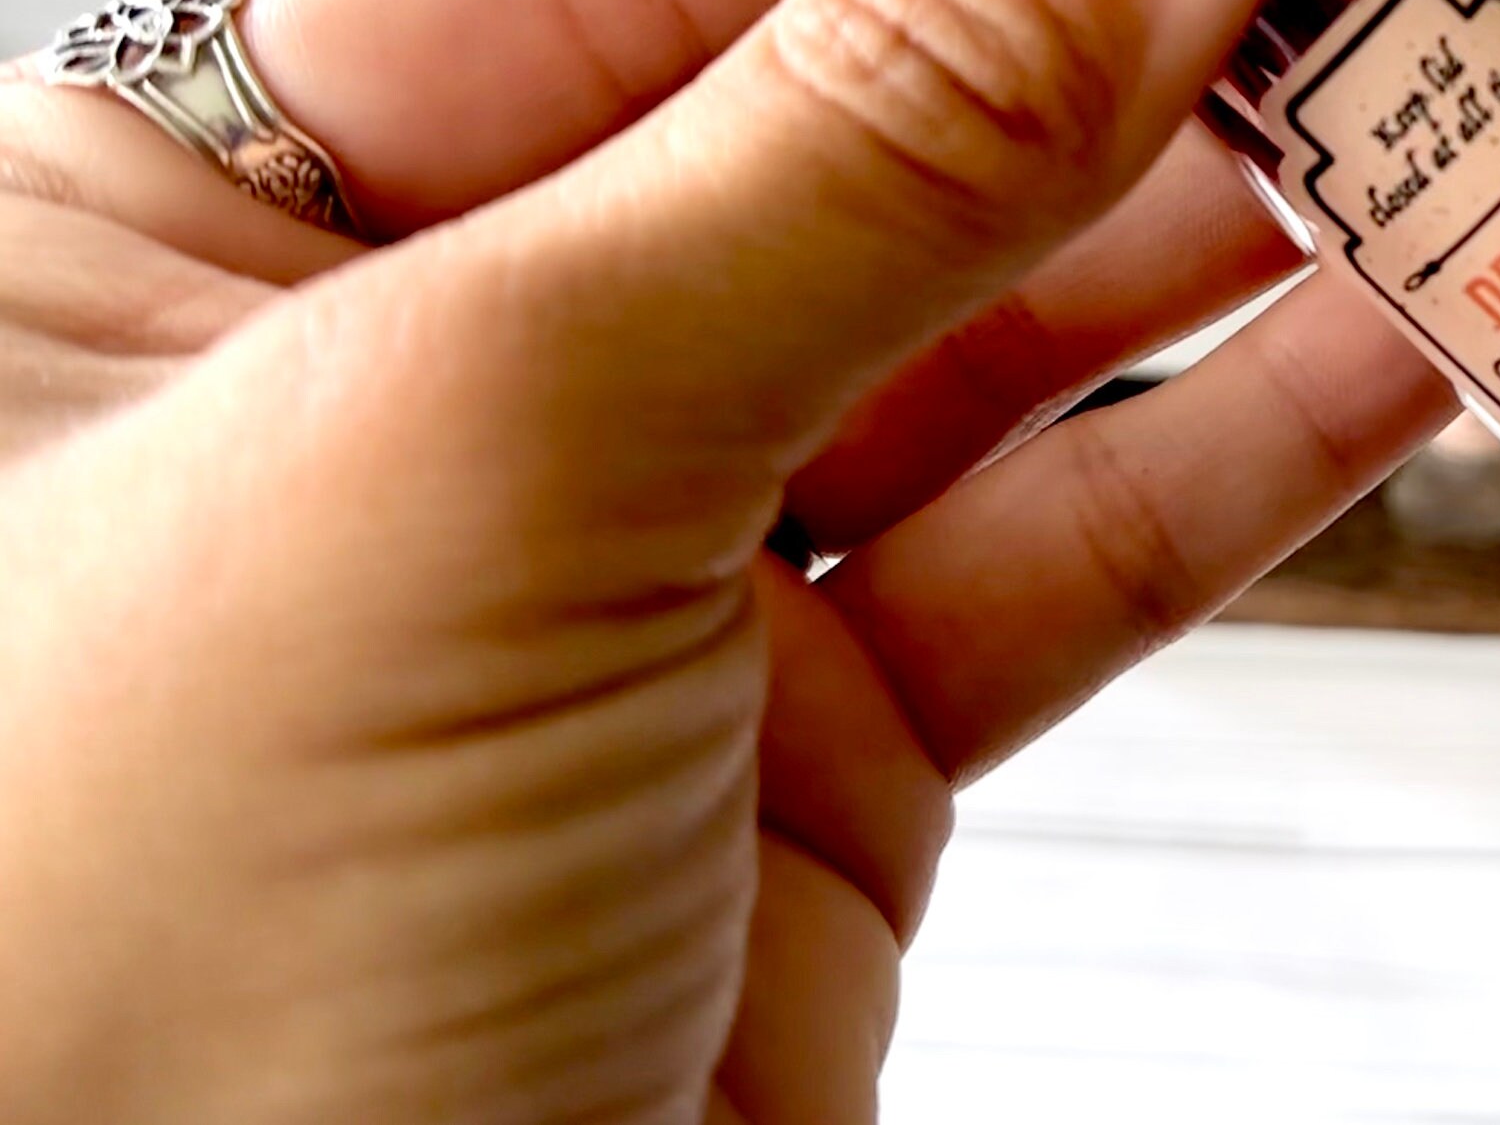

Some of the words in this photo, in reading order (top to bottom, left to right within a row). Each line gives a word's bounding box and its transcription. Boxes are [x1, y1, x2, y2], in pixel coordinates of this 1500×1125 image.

[1367, 150, 1431, 229] closed
[1433, 138, 1457, 171] at
[1458, 86, 1492, 144] all
[1371, 92, 1441, 152] Keep
[1420, 35, 1465, 94] lid
